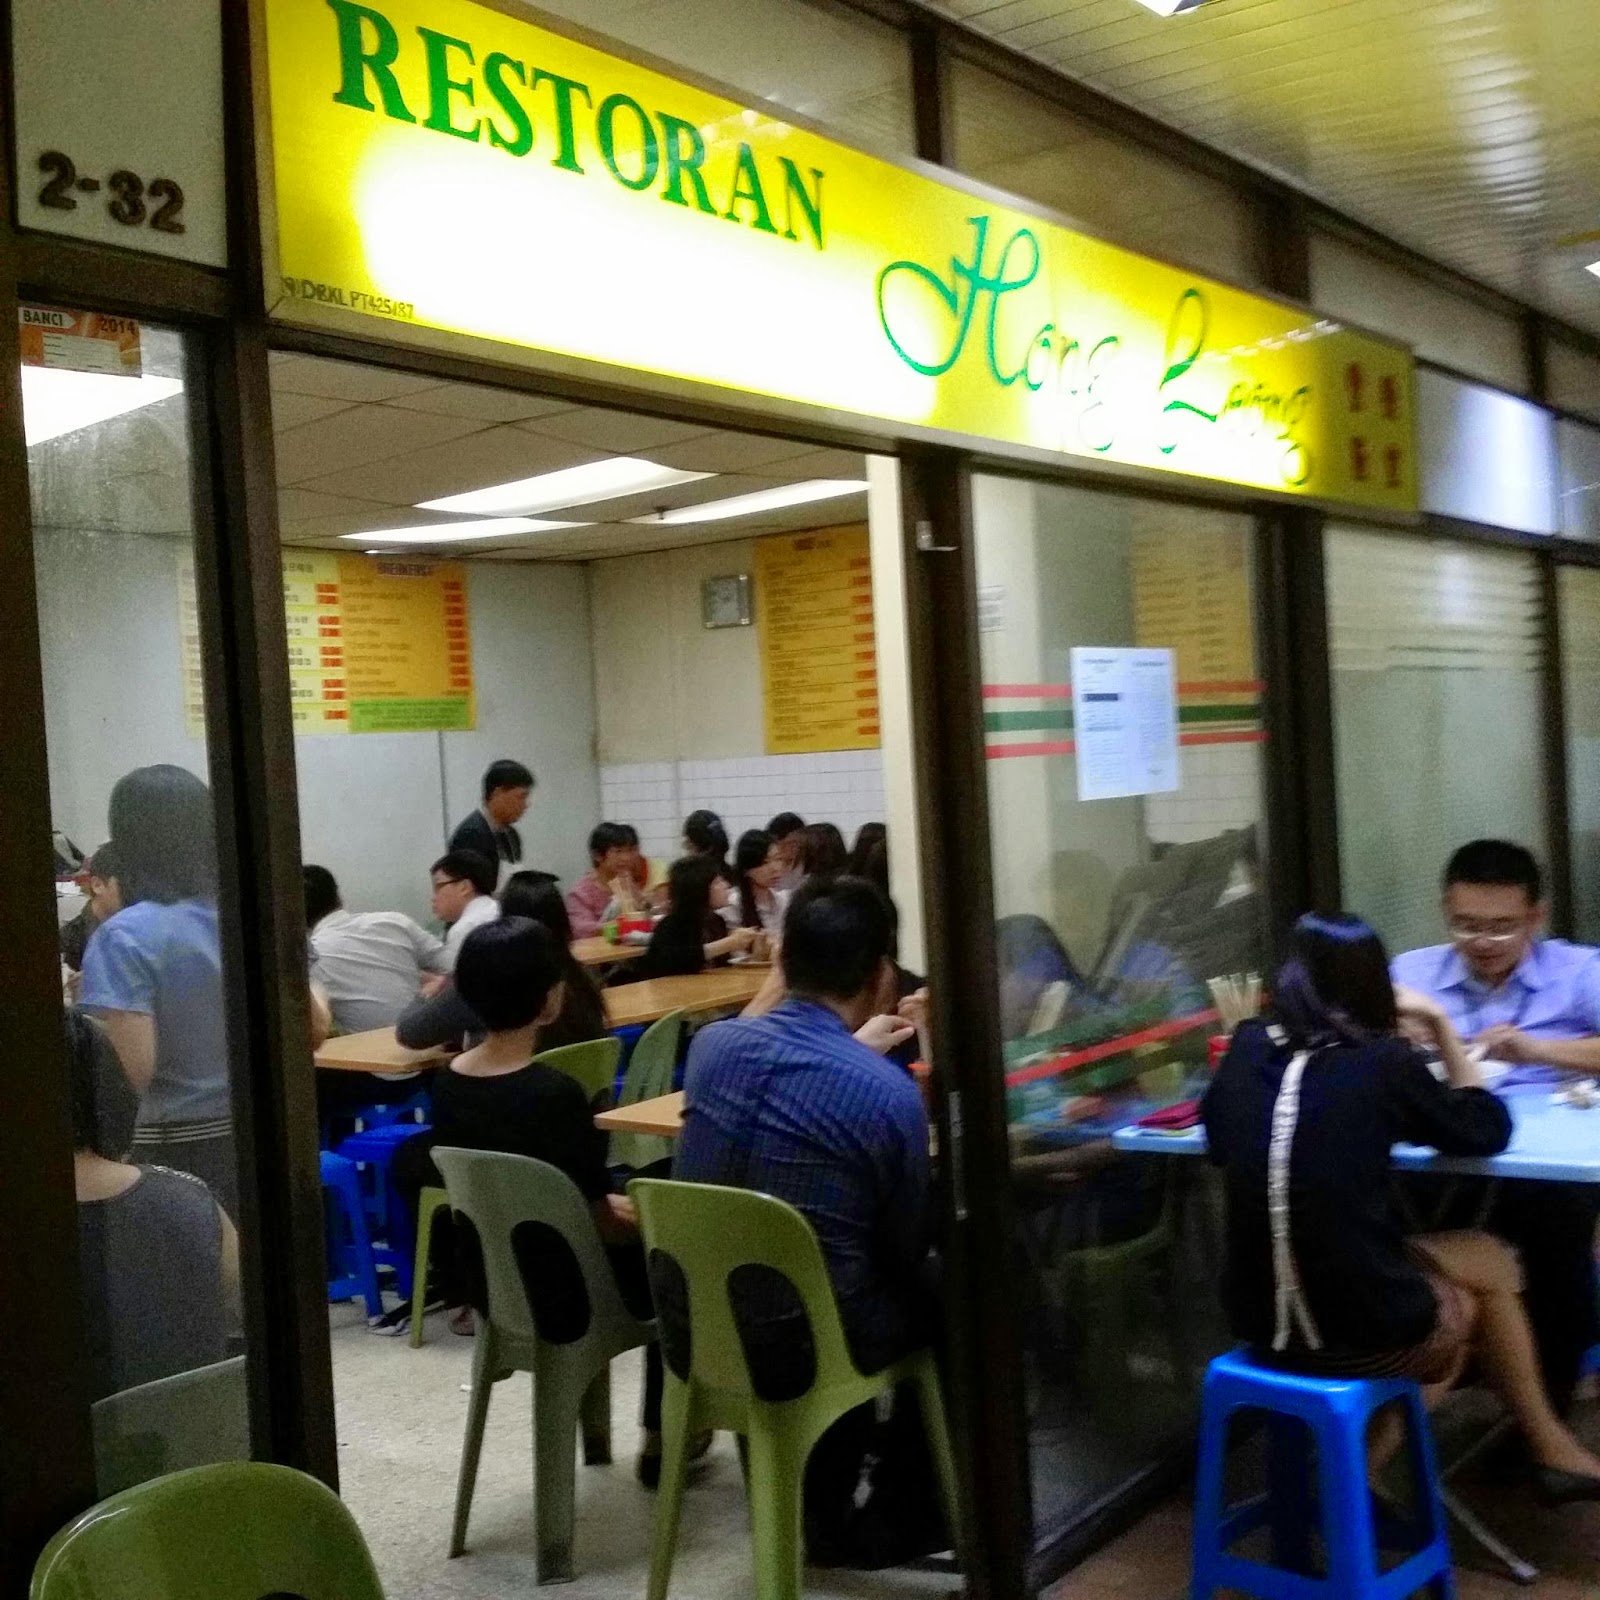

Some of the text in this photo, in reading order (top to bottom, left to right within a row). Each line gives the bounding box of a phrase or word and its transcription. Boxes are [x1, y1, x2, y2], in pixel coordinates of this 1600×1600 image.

[325, 0, 824, 251] RESTORAN
[36, 151, 186, 234] 2-32
[22, 309, 135, 335] BANCI 2014
